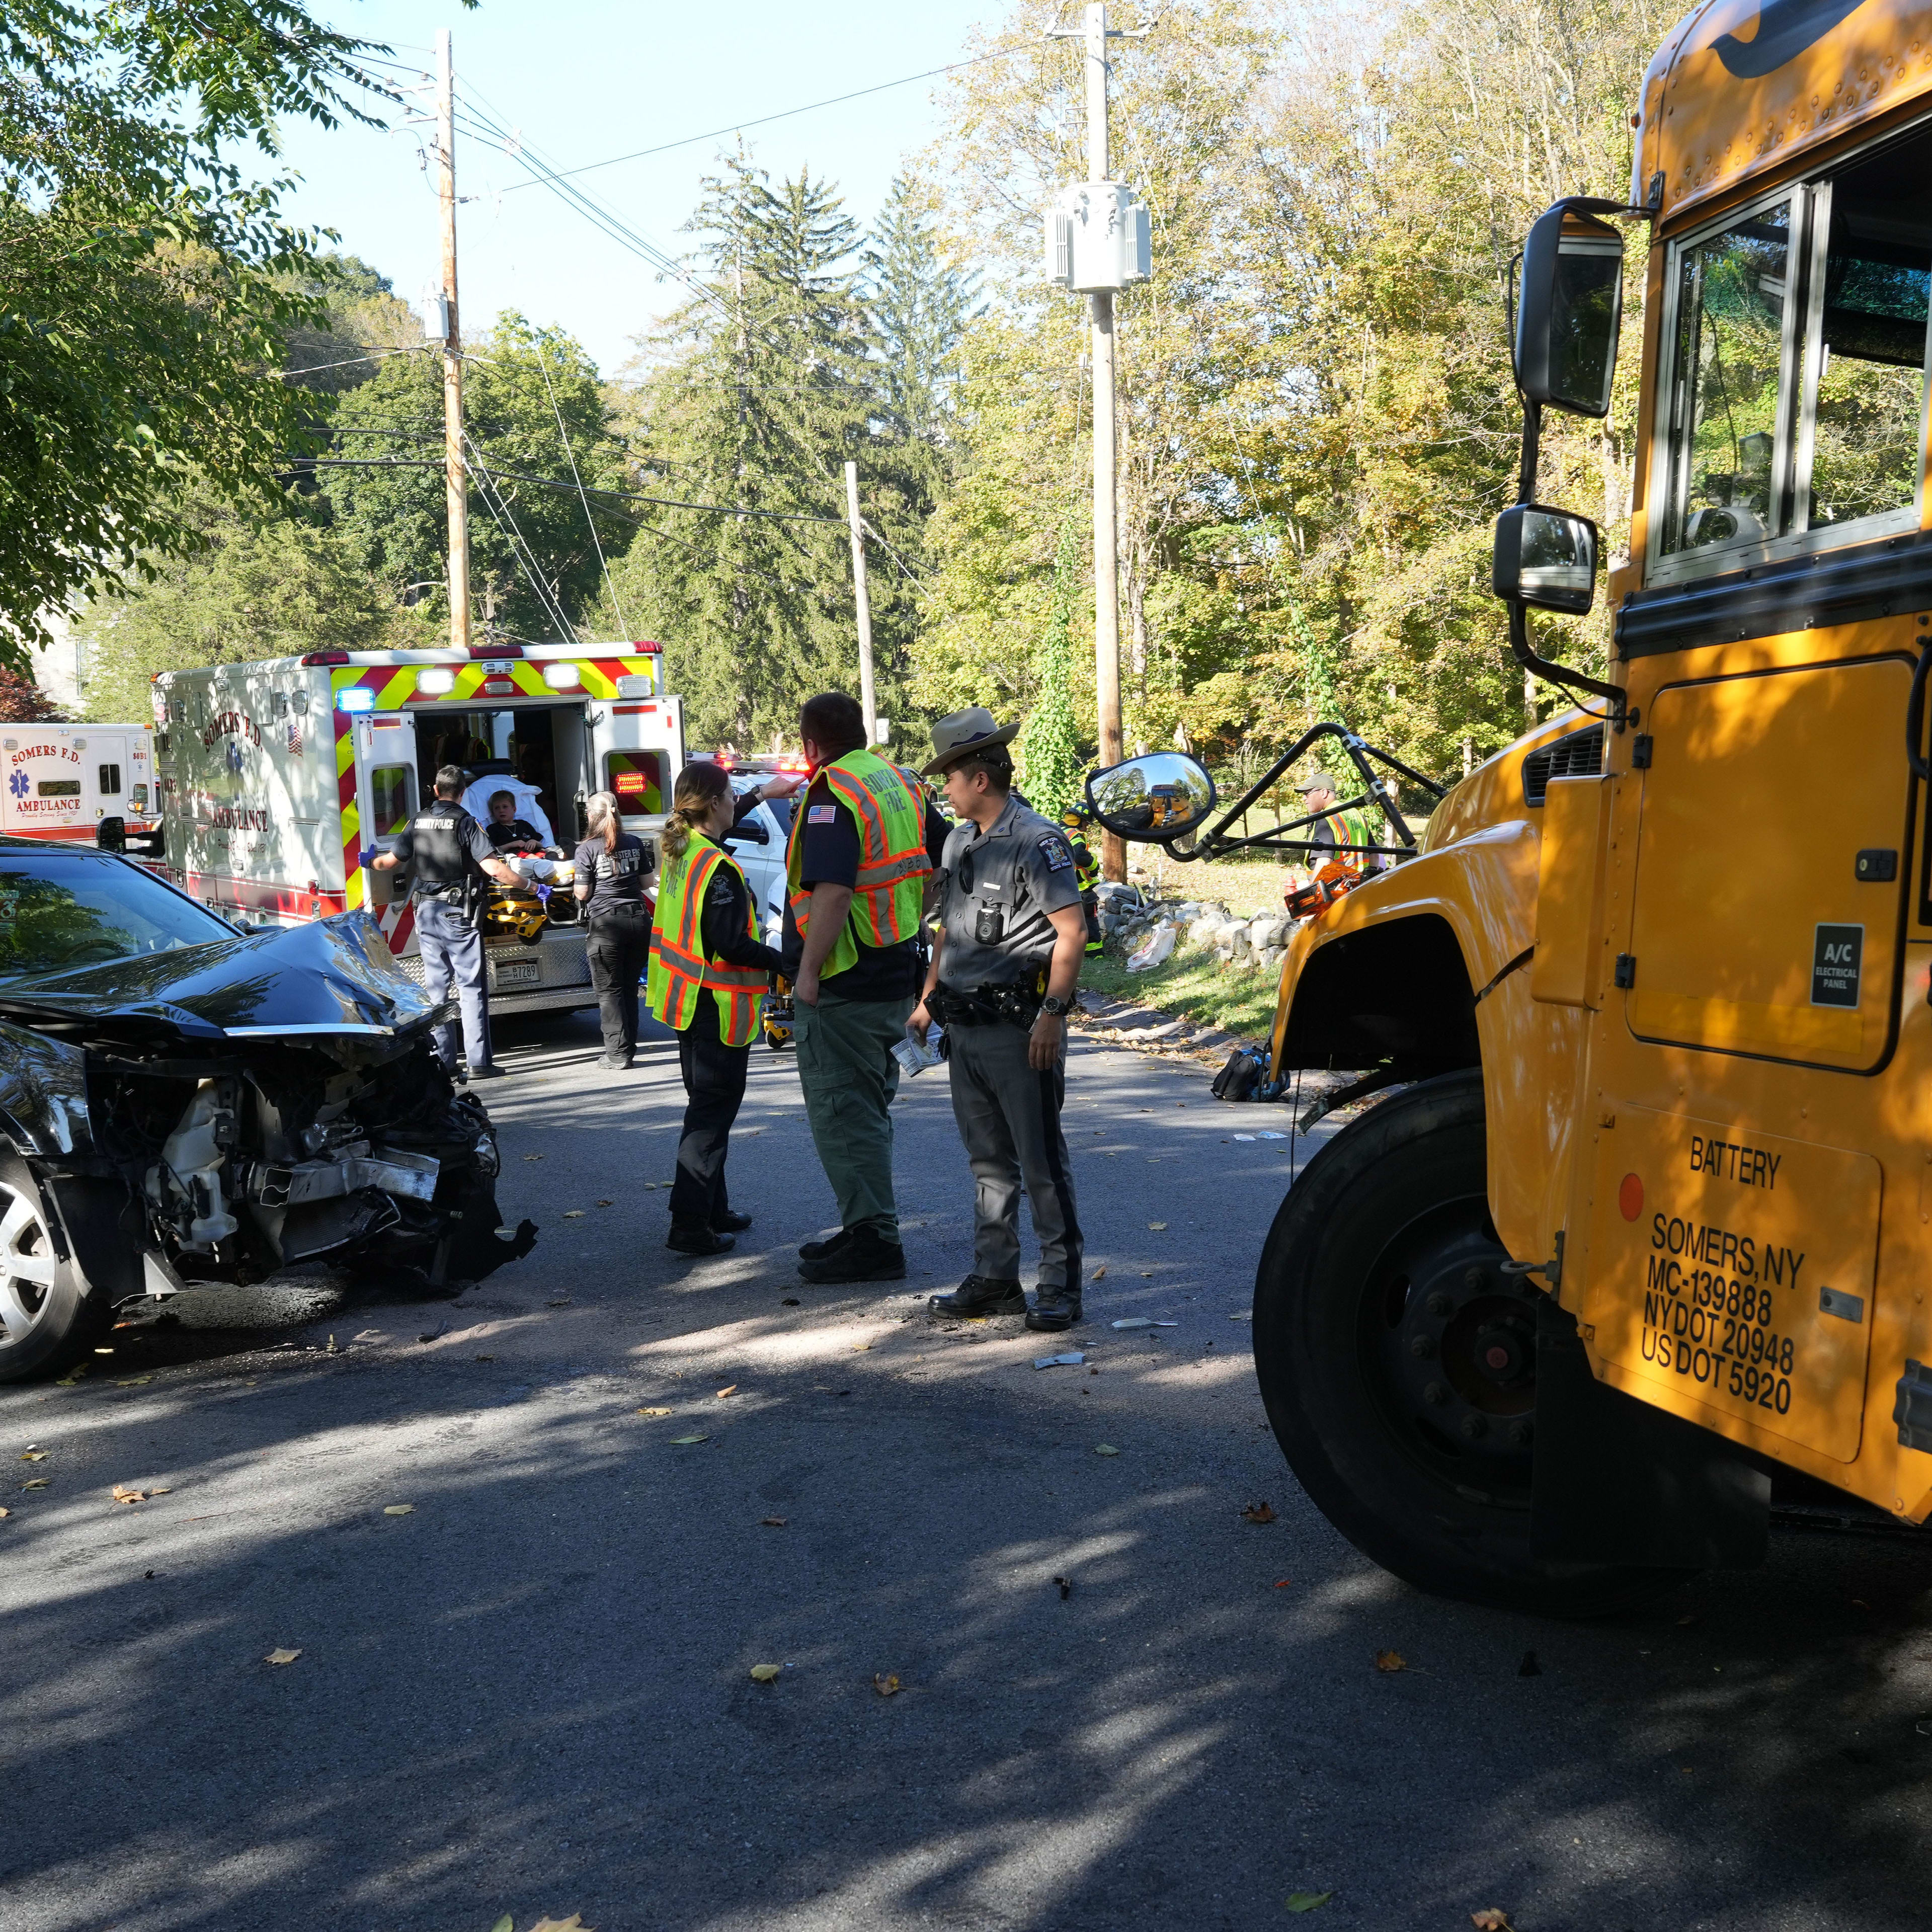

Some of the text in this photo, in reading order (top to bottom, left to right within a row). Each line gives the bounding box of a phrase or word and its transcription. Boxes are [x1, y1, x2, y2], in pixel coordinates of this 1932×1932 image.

[204, 711, 263, 753] SOMERS F.D.
[12, 745, 80, 766] SOMERS F.D.
[16, 799, 80, 812] AMBULANCE
[213, 808, 268, 832] AMBULANCE
[414, 819, 454, 829] COUNTY POLICE
[1824, 943, 1852, 963] A/C
[1815, 967, 1857, 978] ELECTRICAL
[1823, 979, 1847, 989] PANEL
[1690, 1136, 1781, 1189] BATTERY
[1652, 1213, 1805, 1290] SOMERS, NY
[1647, 1254, 1772, 1327] MC-139888
[1644, 1291, 1794, 1376] NY DOT 20948
[1642, 1327, 1791, 1415] US DOT 5920
